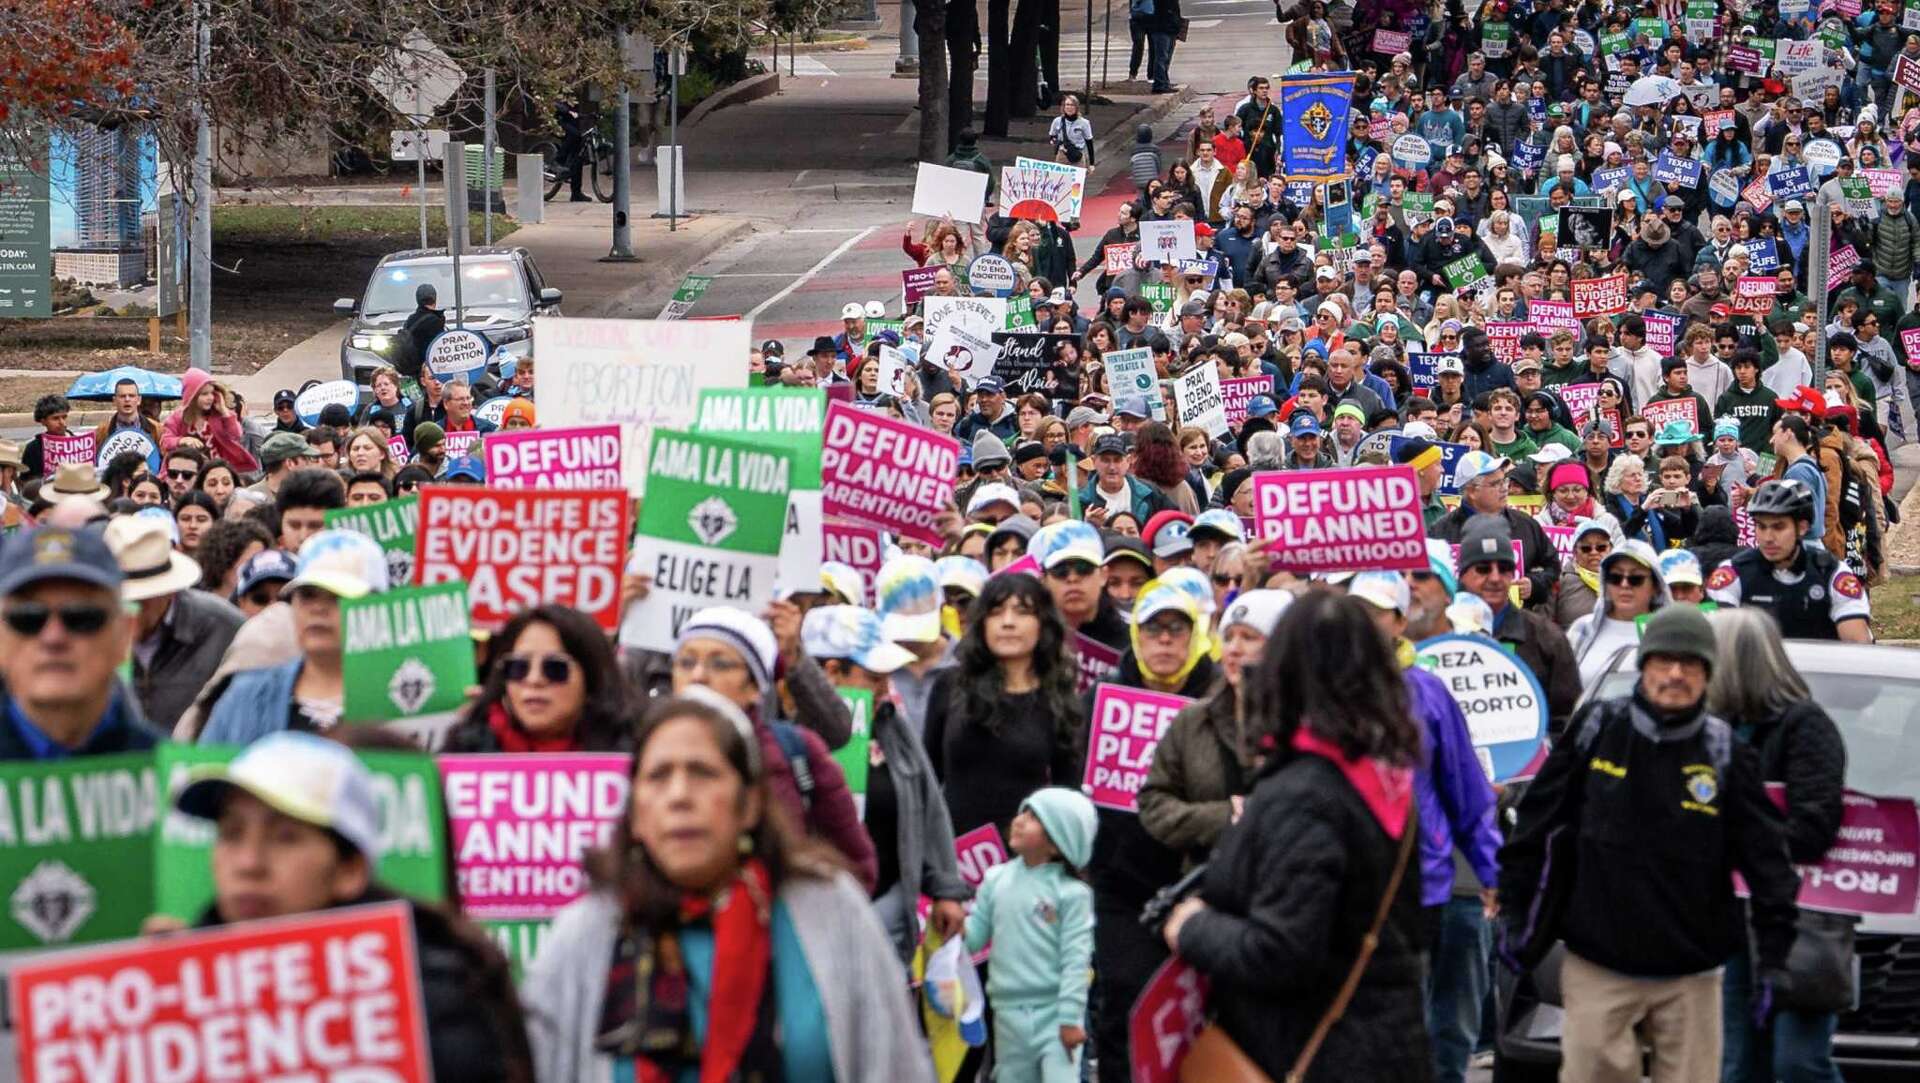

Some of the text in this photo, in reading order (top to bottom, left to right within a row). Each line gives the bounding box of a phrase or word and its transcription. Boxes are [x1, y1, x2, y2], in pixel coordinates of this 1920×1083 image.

[1520, 144, 1542, 154] TEXAS
[1514, 155, 1542, 168] PRO-LIFE
[1525, 154, 1532, 162] IS
[1668, 158, 1692, 170] TEXAS
[1600, 168, 1626, 181] TEXAS
[1658, 170, 1696, 184] PRO-LIFE
[1674, 166, 1682, 174] IS
[1776, 170, 1800, 180] TEXAS
[1862, 172, 1901, 181] DEFUND
[1610, 178, 1619, 186] IS
[1774, 184, 1810, 197] PRO-LIFE
[0, 250, 28, 258] ODAY:
[1750, 252, 1758, 260] IS
[981, 258, 1003, 266] PRAY
[1108, 260, 1134, 270] BAS
[1181, 260, 1210, 271] TEXAS
[1446, 253, 1481, 278] LOVE LIFE
[1750, 256, 1776, 269] -LIFE
[976, 265, 1006, 274] TO END
[971, 272, 1012, 282] ABORTION
[1574, 278, 1624, 292] PRO-LIFE IS
[1739, 282, 1776, 294] DEFUND
[1574, 286, 1626, 301] EVIDENCE
[1018, 298, 1032, 312] LIFE
[1531, 304, 1574, 318] DEFUN
[1574, 298, 1625, 314] BASED
[1734, 298, 1773, 311] BASED
[956, 300, 995, 325] DESERVES
[1530, 316, 1578, 328] PLANNED
[1646, 322, 1671, 334] UND
[1486, 324, 1536, 338] DEFUND
[442, 334, 470, 346] PRAY
[438, 341, 476, 355] TO END
[998, 337, 1047, 361] Stand
[431, 350, 484, 364] ABORTION
[1107, 350, 1148, 363] FERTILIZATION
[1418, 356, 1438, 366] TEX
[1114, 362, 1146, 372] CREATES A
[562, 361, 699, 406] ABORTION
[1186, 369, 1206, 389] PRAY
[1414, 374, 1438, 385] PRO-
[1184, 391, 1196, 406] TO
[1196, 383, 1213, 400] END
[1562, 387, 1599, 400] DEFU
[490, 404, 506, 412] PR
[1182, 392, 1222, 424] ABORTION
[1684, 402, 1693, 411] IS
[1732, 405, 1768, 418] JESUIT
[486, 414, 499, 422] TO
[700, 396, 744, 432] AMA
[748, 396, 772, 432] LA
[774, 396, 822, 433] VIDA
[43, 436, 94, 454] DEFUND
[102, 436, 122, 460] PRAY
[827, 414, 956, 482] DEFUND
[1370, 442, 1384, 450] TO
[492, 434, 620, 475] DEFUND
[650, 438, 790, 494] AMA LA VIDA
[822, 449, 954, 511] PLANNED
[1260, 476, 1414, 518] DEFUND
[822, 481, 940, 530] ARENTHOO
[428, 498, 618, 529] PRO-LIFE IS
[373, 510, 402, 541] LA
[1263, 511, 1418, 547] PLANNED
[425, 528, 618, 564] EVIDENCE
[1267, 540, 1422, 568] PARENTHOOD
[655, 554, 752, 600] ELIGE LA
[345, 603, 393, 653] AMA
[392, 599, 423, 648] LA
[1452, 670, 1519, 690] EL FIN
[1460, 694, 1534, 716] BORTO
[1101, 698, 1175, 738] DEF
[446, 769, 631, 821] EFUND
[18, 768, 158, 843] LA VIDA
[460, 820, 618, 862] ANNE
[1838, 826, 1884, 844] SAVIN
[1827, 848, 1916, 868] EMPOWERIN
[456, 864, 587, 897] ENTHO
[29, 932, 394, 1040] PRO-LIFE IS
[36, 991, 404, 1083] EVIDENCE
